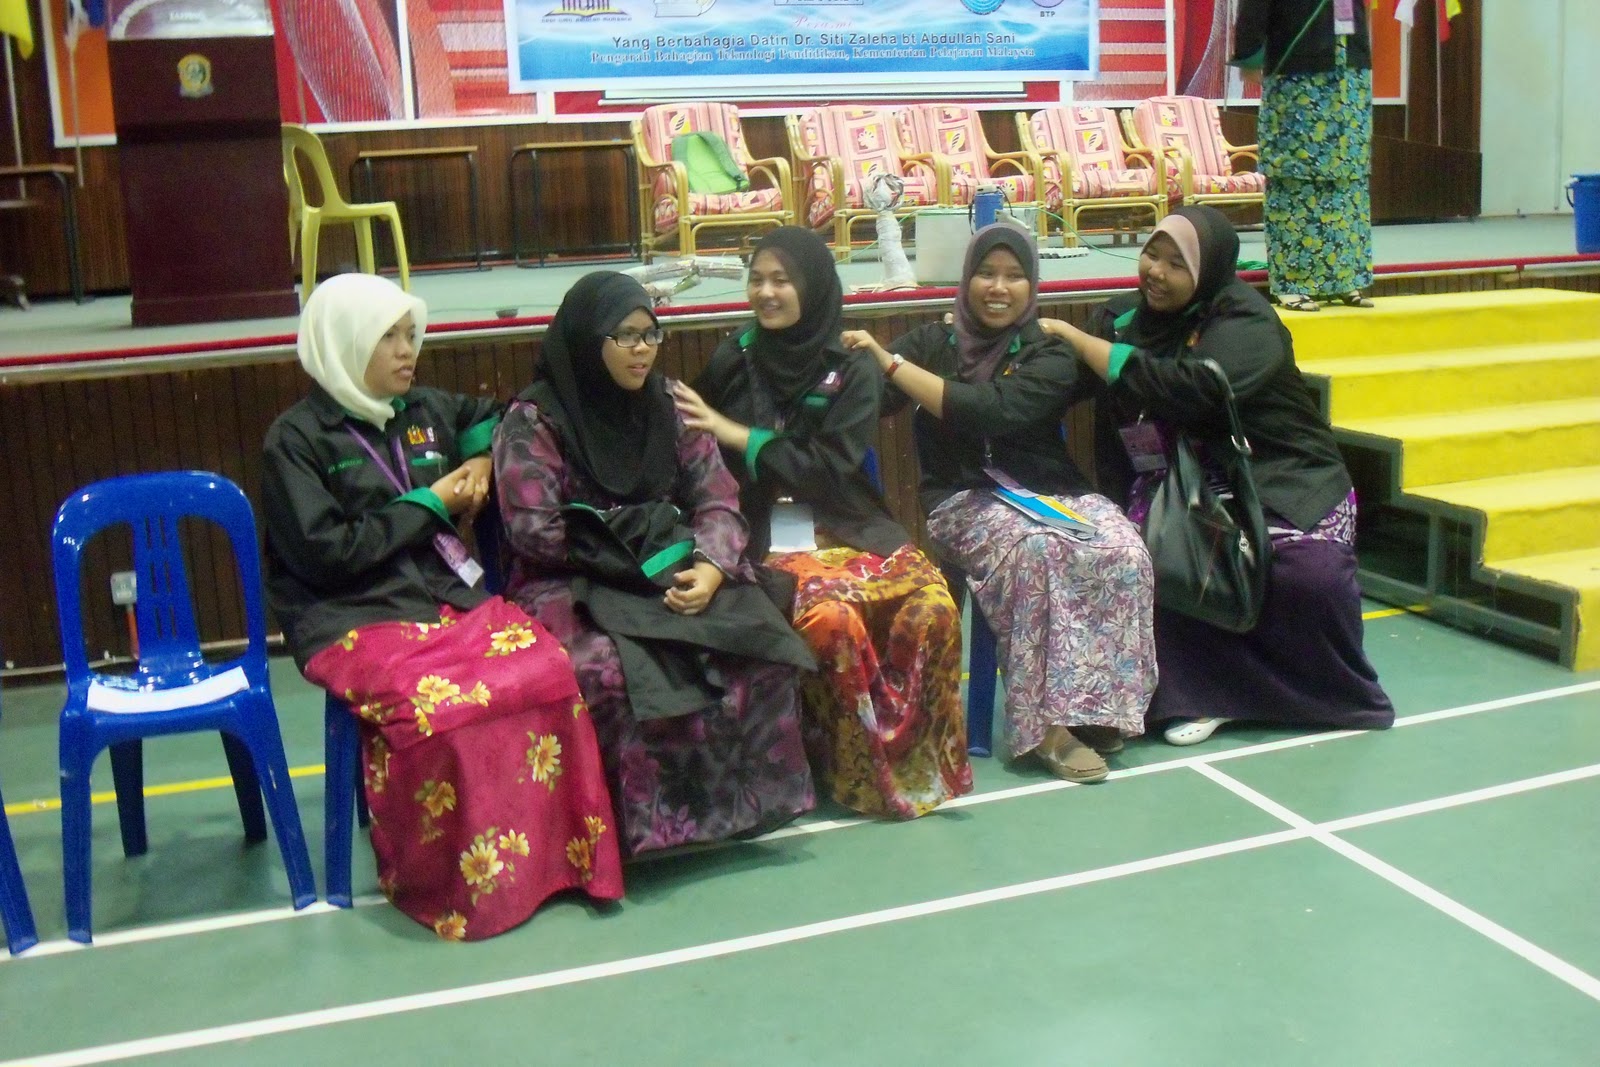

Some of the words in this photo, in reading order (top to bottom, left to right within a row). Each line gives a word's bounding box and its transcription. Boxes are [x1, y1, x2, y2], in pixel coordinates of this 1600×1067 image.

[612, 36, 650, 50] Yang
[656, 34, 745, 50] Berbahagia
[750, 34, 789, 46] Datin
[794, 33, 814, 45] Dr.
[819, 33, 844, 45] Siti
[849, 33, 897, 45] Zaleha
[902, 33, 915, 44] bt
[921, 32, 981, 44] Abdullah
[986, 32, 1016, 44] Sani
[591, 51, 650, 65] Pengarah
[655, 49, 713, 64] Bahagian
[717, 48, 776, 63] Teknologi
[852, 47, 927, 58] Kementerian
[929, 46, 983, 59] Pelajaran
[986, 46, 1036, 59] Malaysia
